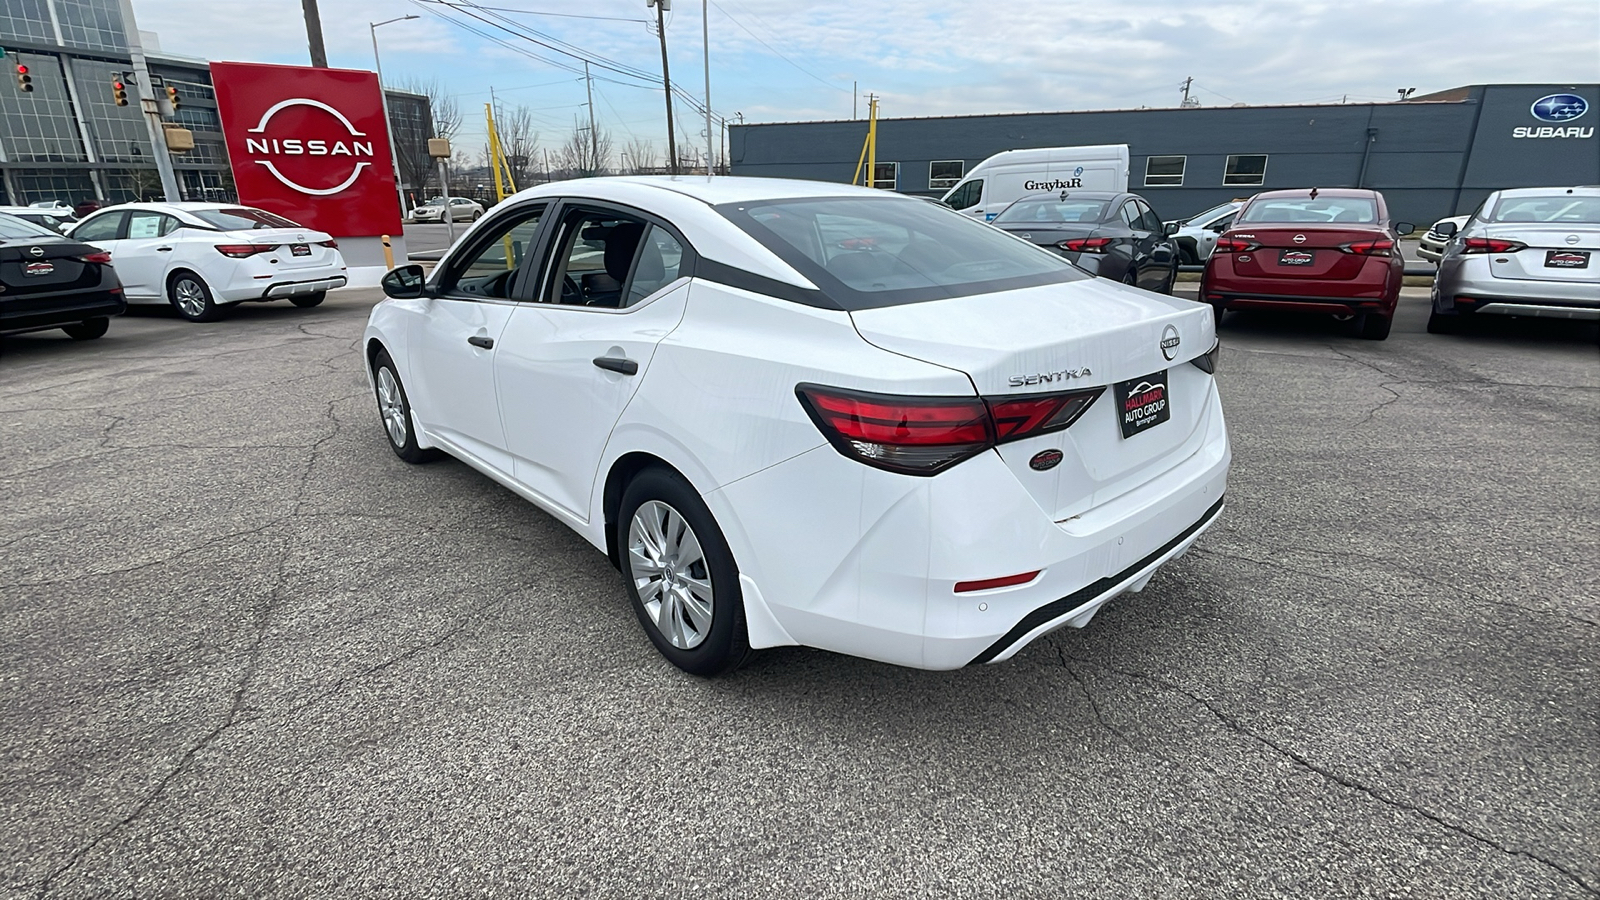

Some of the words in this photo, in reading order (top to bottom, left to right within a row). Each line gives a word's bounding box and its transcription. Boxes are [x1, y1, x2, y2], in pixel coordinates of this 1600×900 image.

[1512, 127, 1594, 138] SUBARU
[246, 138, 374, 156] NISSAN
[1024, 178, 1082, 192] GraybaR
[1161, 339, 1179, 348] NISSA
[1009, 367, 1092, 387] SENTRA
[1125, 388, 1164, 411] HALLMARK
[1125, 408, 1143, 423] AUTO
[1144, 400, 1166, 416] GROUP
[1136, 414, 1157, 427] Birmingham
